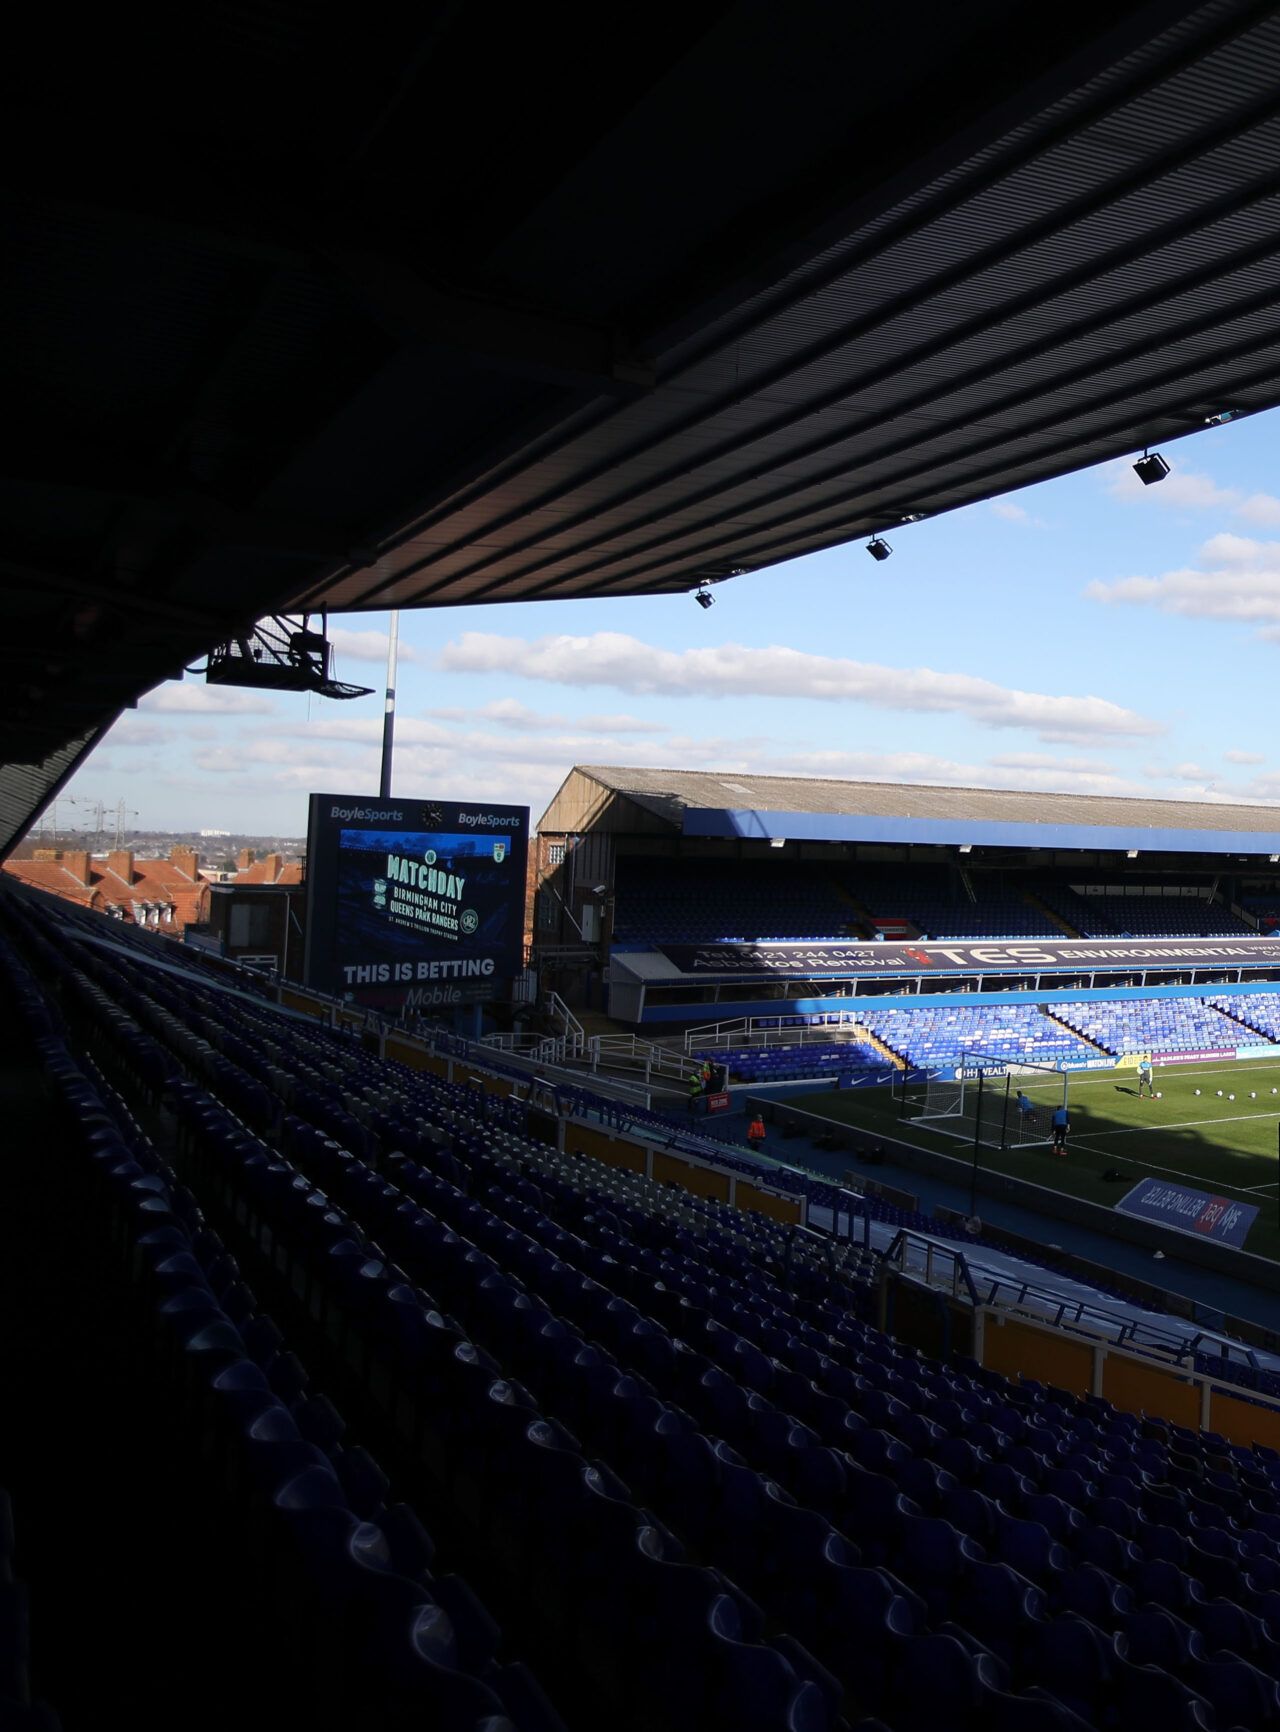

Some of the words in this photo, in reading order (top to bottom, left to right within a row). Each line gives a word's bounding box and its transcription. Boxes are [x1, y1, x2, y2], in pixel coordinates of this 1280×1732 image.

[330, 806, 404, 821] BoyleSports
[458, 812, 521, 827] BoyleSports
[387, 854, 465, 900] MATCHDAY
[394, 886, 438, 910] BIRMINGHAM
[440, 901, 457, 916] CITY
[390, 900, 414, 917] QUEENS
[415, 908, 431, 922] PARK
[432, 914, 459, 931] RANGERS
[693, 959, 803, 968] Asbestos
[807, 957, 907, 967] Removal
[739, 951, 788, 959] 0121
[792, 951, 829, 959] 244
[832, 950, 876, 958] 0427
[924, 947, 1057, 965] TES
[1057, 947, 1256, 959] ENVIRONMENTAL
[344, 964, 390, 985] THIS
[395, 963, 413, 981] IS
[417, 958, 495, 980] BETTING
[405, 986, 462, 1006] Mobile
